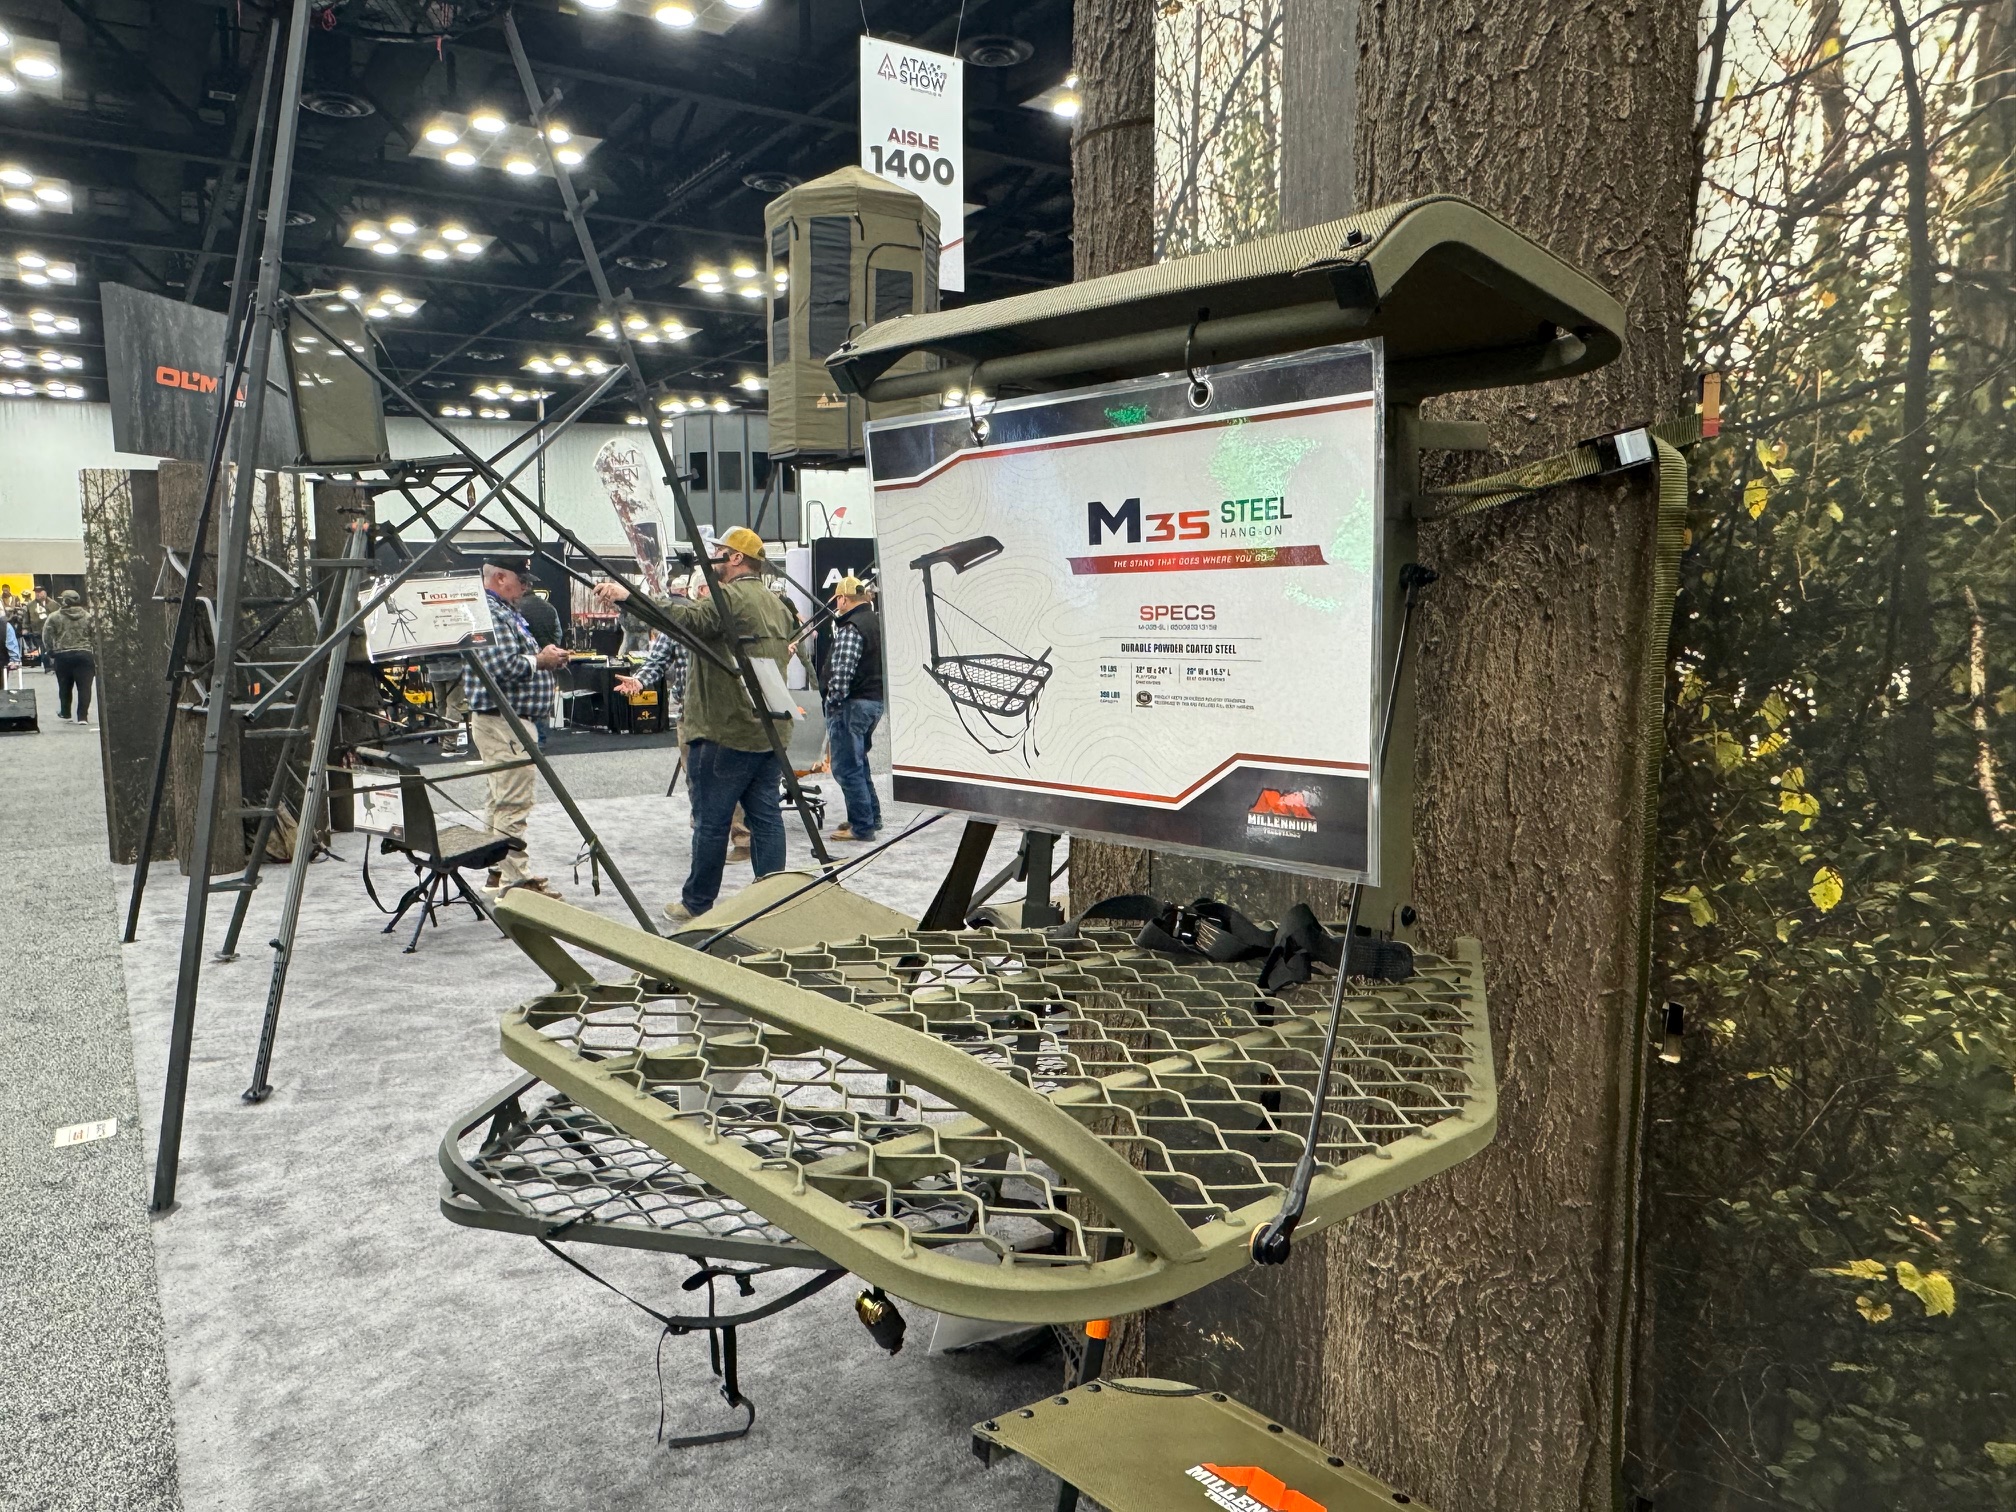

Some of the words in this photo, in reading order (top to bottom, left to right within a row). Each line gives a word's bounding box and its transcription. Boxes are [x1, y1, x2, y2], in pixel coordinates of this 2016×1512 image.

[900, 56, 928, 75] ATA
[900, 70, 946, 92] SHOW
[887, 127, 939, 151] AISLE
[870, 145, 955, 186] 1400
[1220, 497, 1292, 524] STEEL
[1088, 497, 1210, 546] M35
[1220, 525, 1283, 539] HANG-ON
[1113, 560, 1127, 568] THE
[1130, 559, 1154, 567] STAND
[1158, 558, 1176, 566] THAT
[1179, 556, 1200, 565] GOES
[1203, 555, 1232, 564] WHERE
[1235, 554, 1252, 563] YOU
[1140, 604, 1216, 621] SPECS
[1121, 643, 1152, 653] DURABLE
[1153, 643, 1184, 653] POWDER
[1186, 643, 1213, 654] COATED
[1215, 644, 1237, 655] STEEL
[1247, 813, 1318, 833] MILLENNIUM
